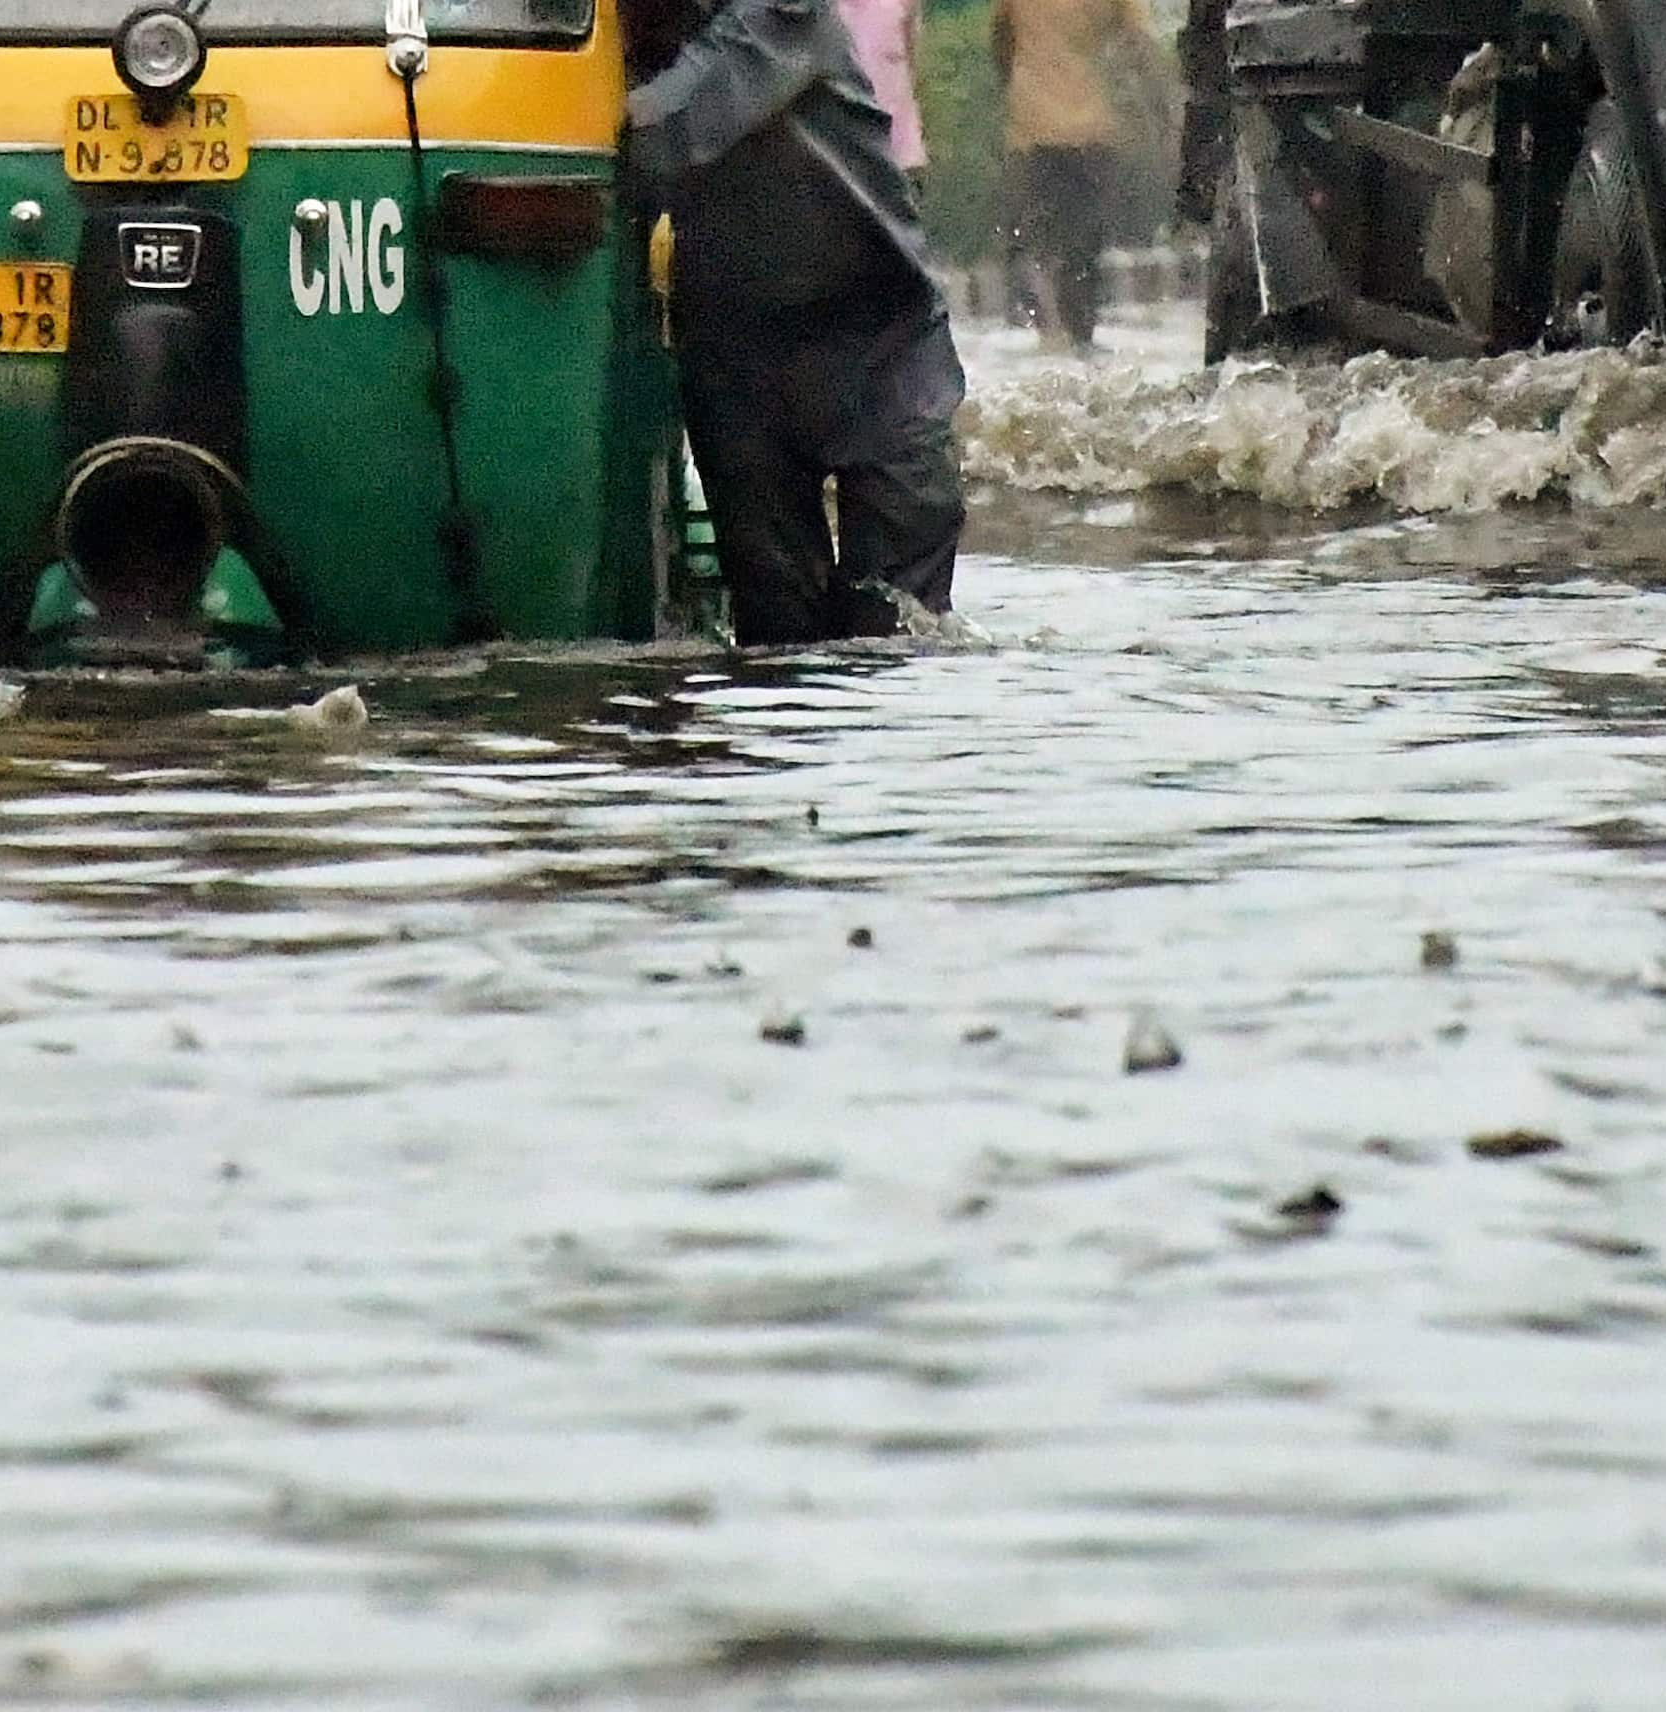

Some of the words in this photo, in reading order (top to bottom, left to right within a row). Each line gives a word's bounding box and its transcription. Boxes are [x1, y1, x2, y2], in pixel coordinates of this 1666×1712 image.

[76, 99, 121, 131] DL
[134, 244, 183, 272] RE
[289, 197, 404, 316] CNG
